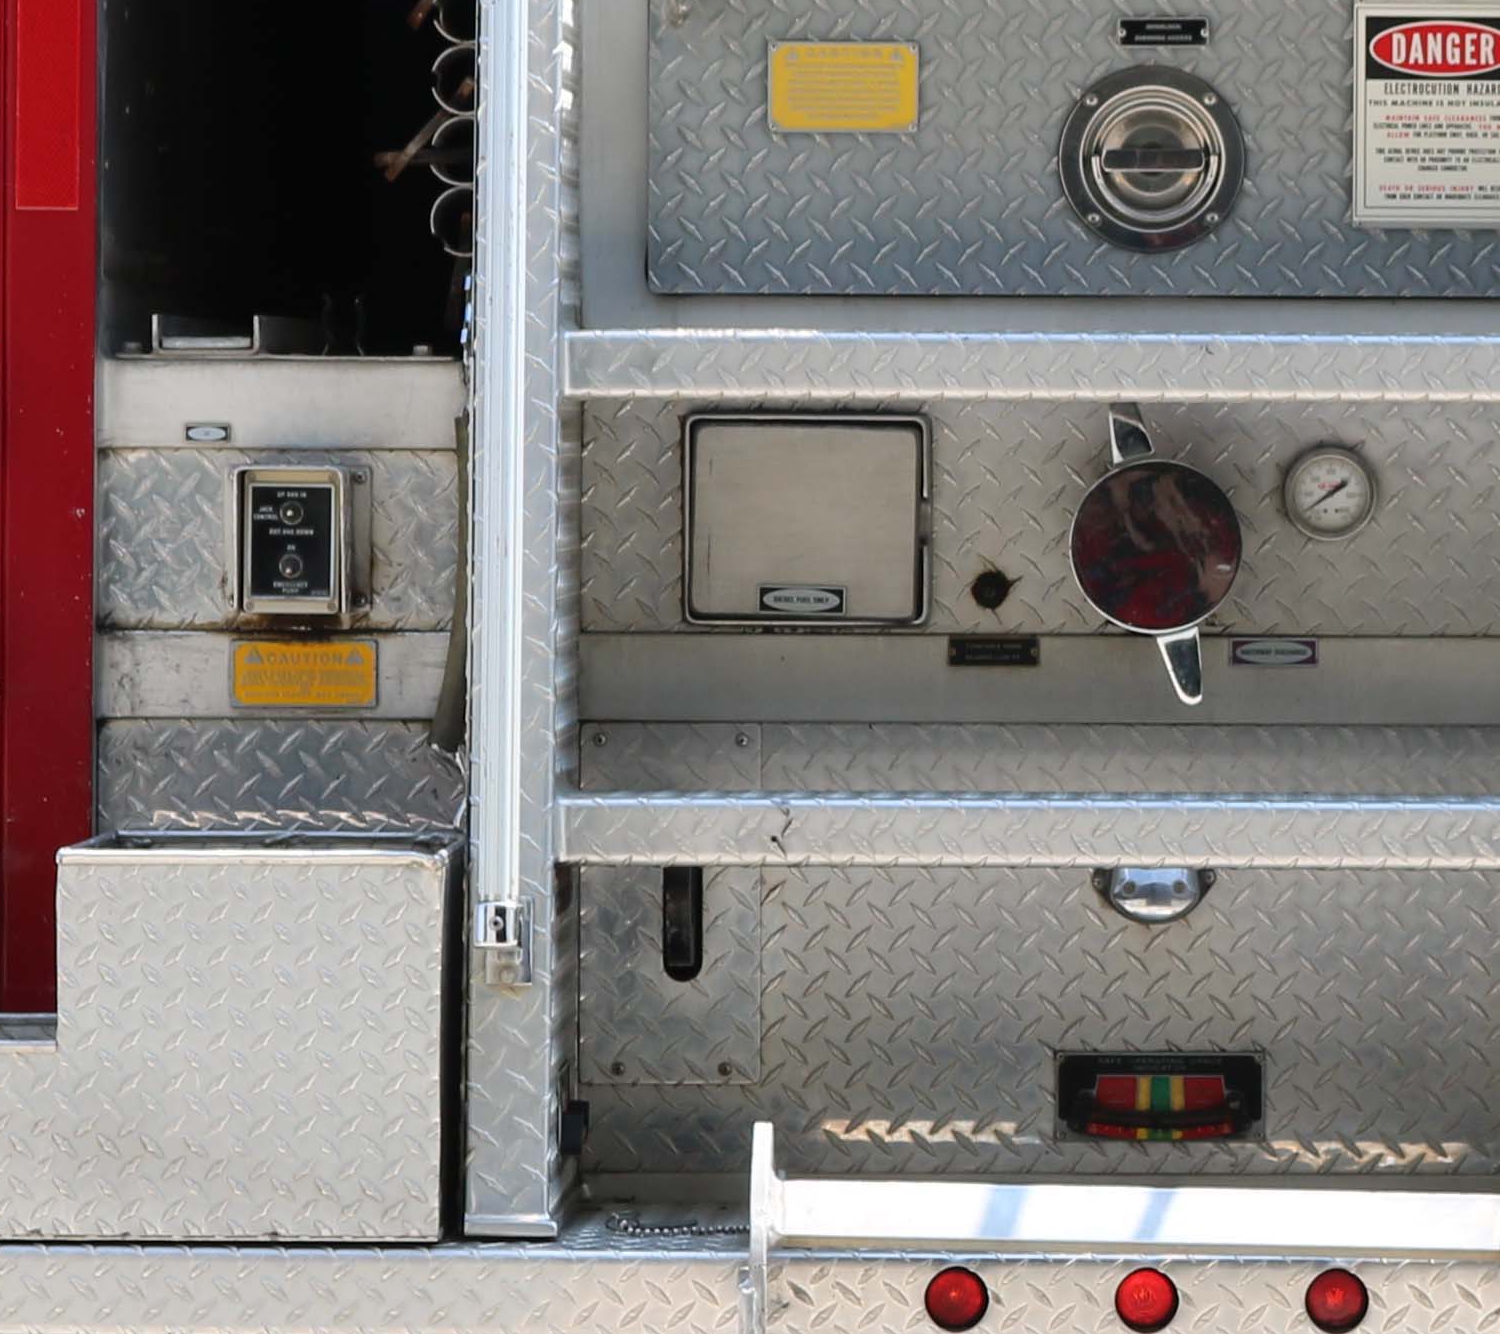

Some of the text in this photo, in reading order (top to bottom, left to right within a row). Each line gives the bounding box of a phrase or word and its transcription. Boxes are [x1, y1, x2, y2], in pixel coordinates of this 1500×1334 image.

[1392, 32, 1496, 65] DANGER
[1384, 83, 1459, 95] ELECTROCUTION
[268, 651, 343, 664] CAUTION
